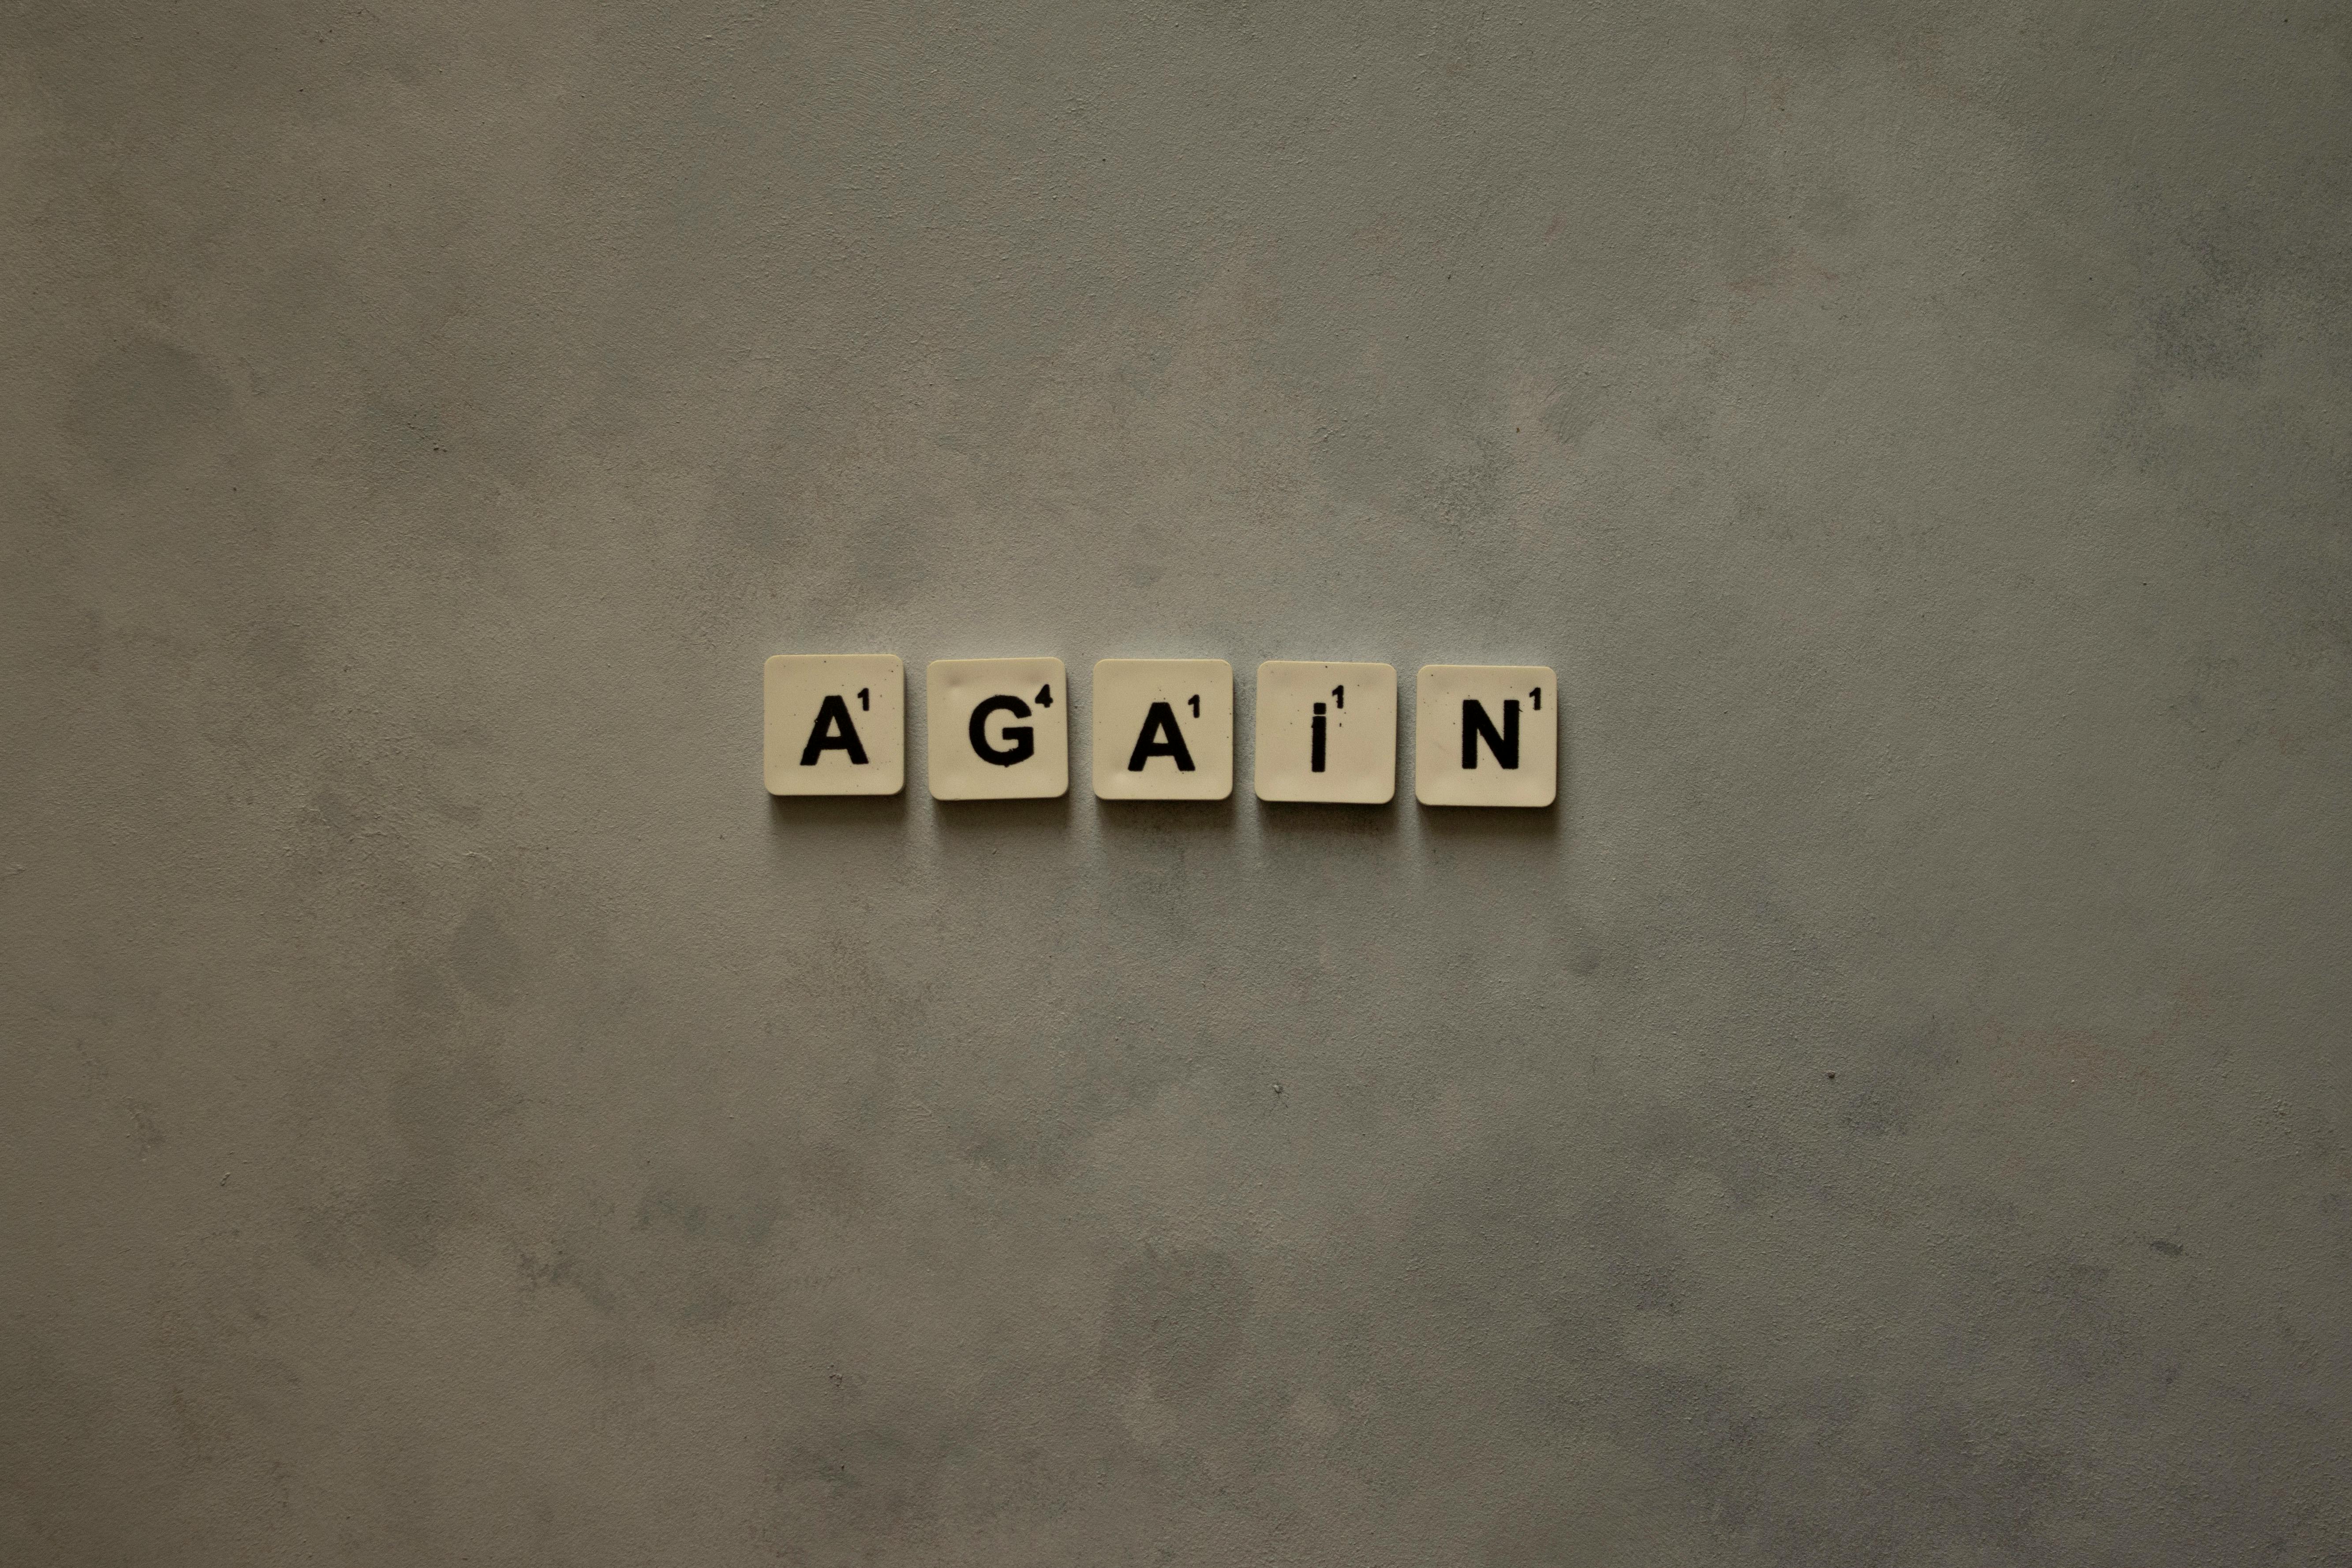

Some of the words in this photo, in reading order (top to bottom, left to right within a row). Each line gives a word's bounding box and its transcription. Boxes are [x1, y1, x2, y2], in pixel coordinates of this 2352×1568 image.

[857, 688, 869, 711] 1
[1035, 684, 1053, 708] 4
[1188, 694, 1200, 718] 1
[1332, 685, 1344, 709] 1
[1529, 687, 1541, 711] 1
